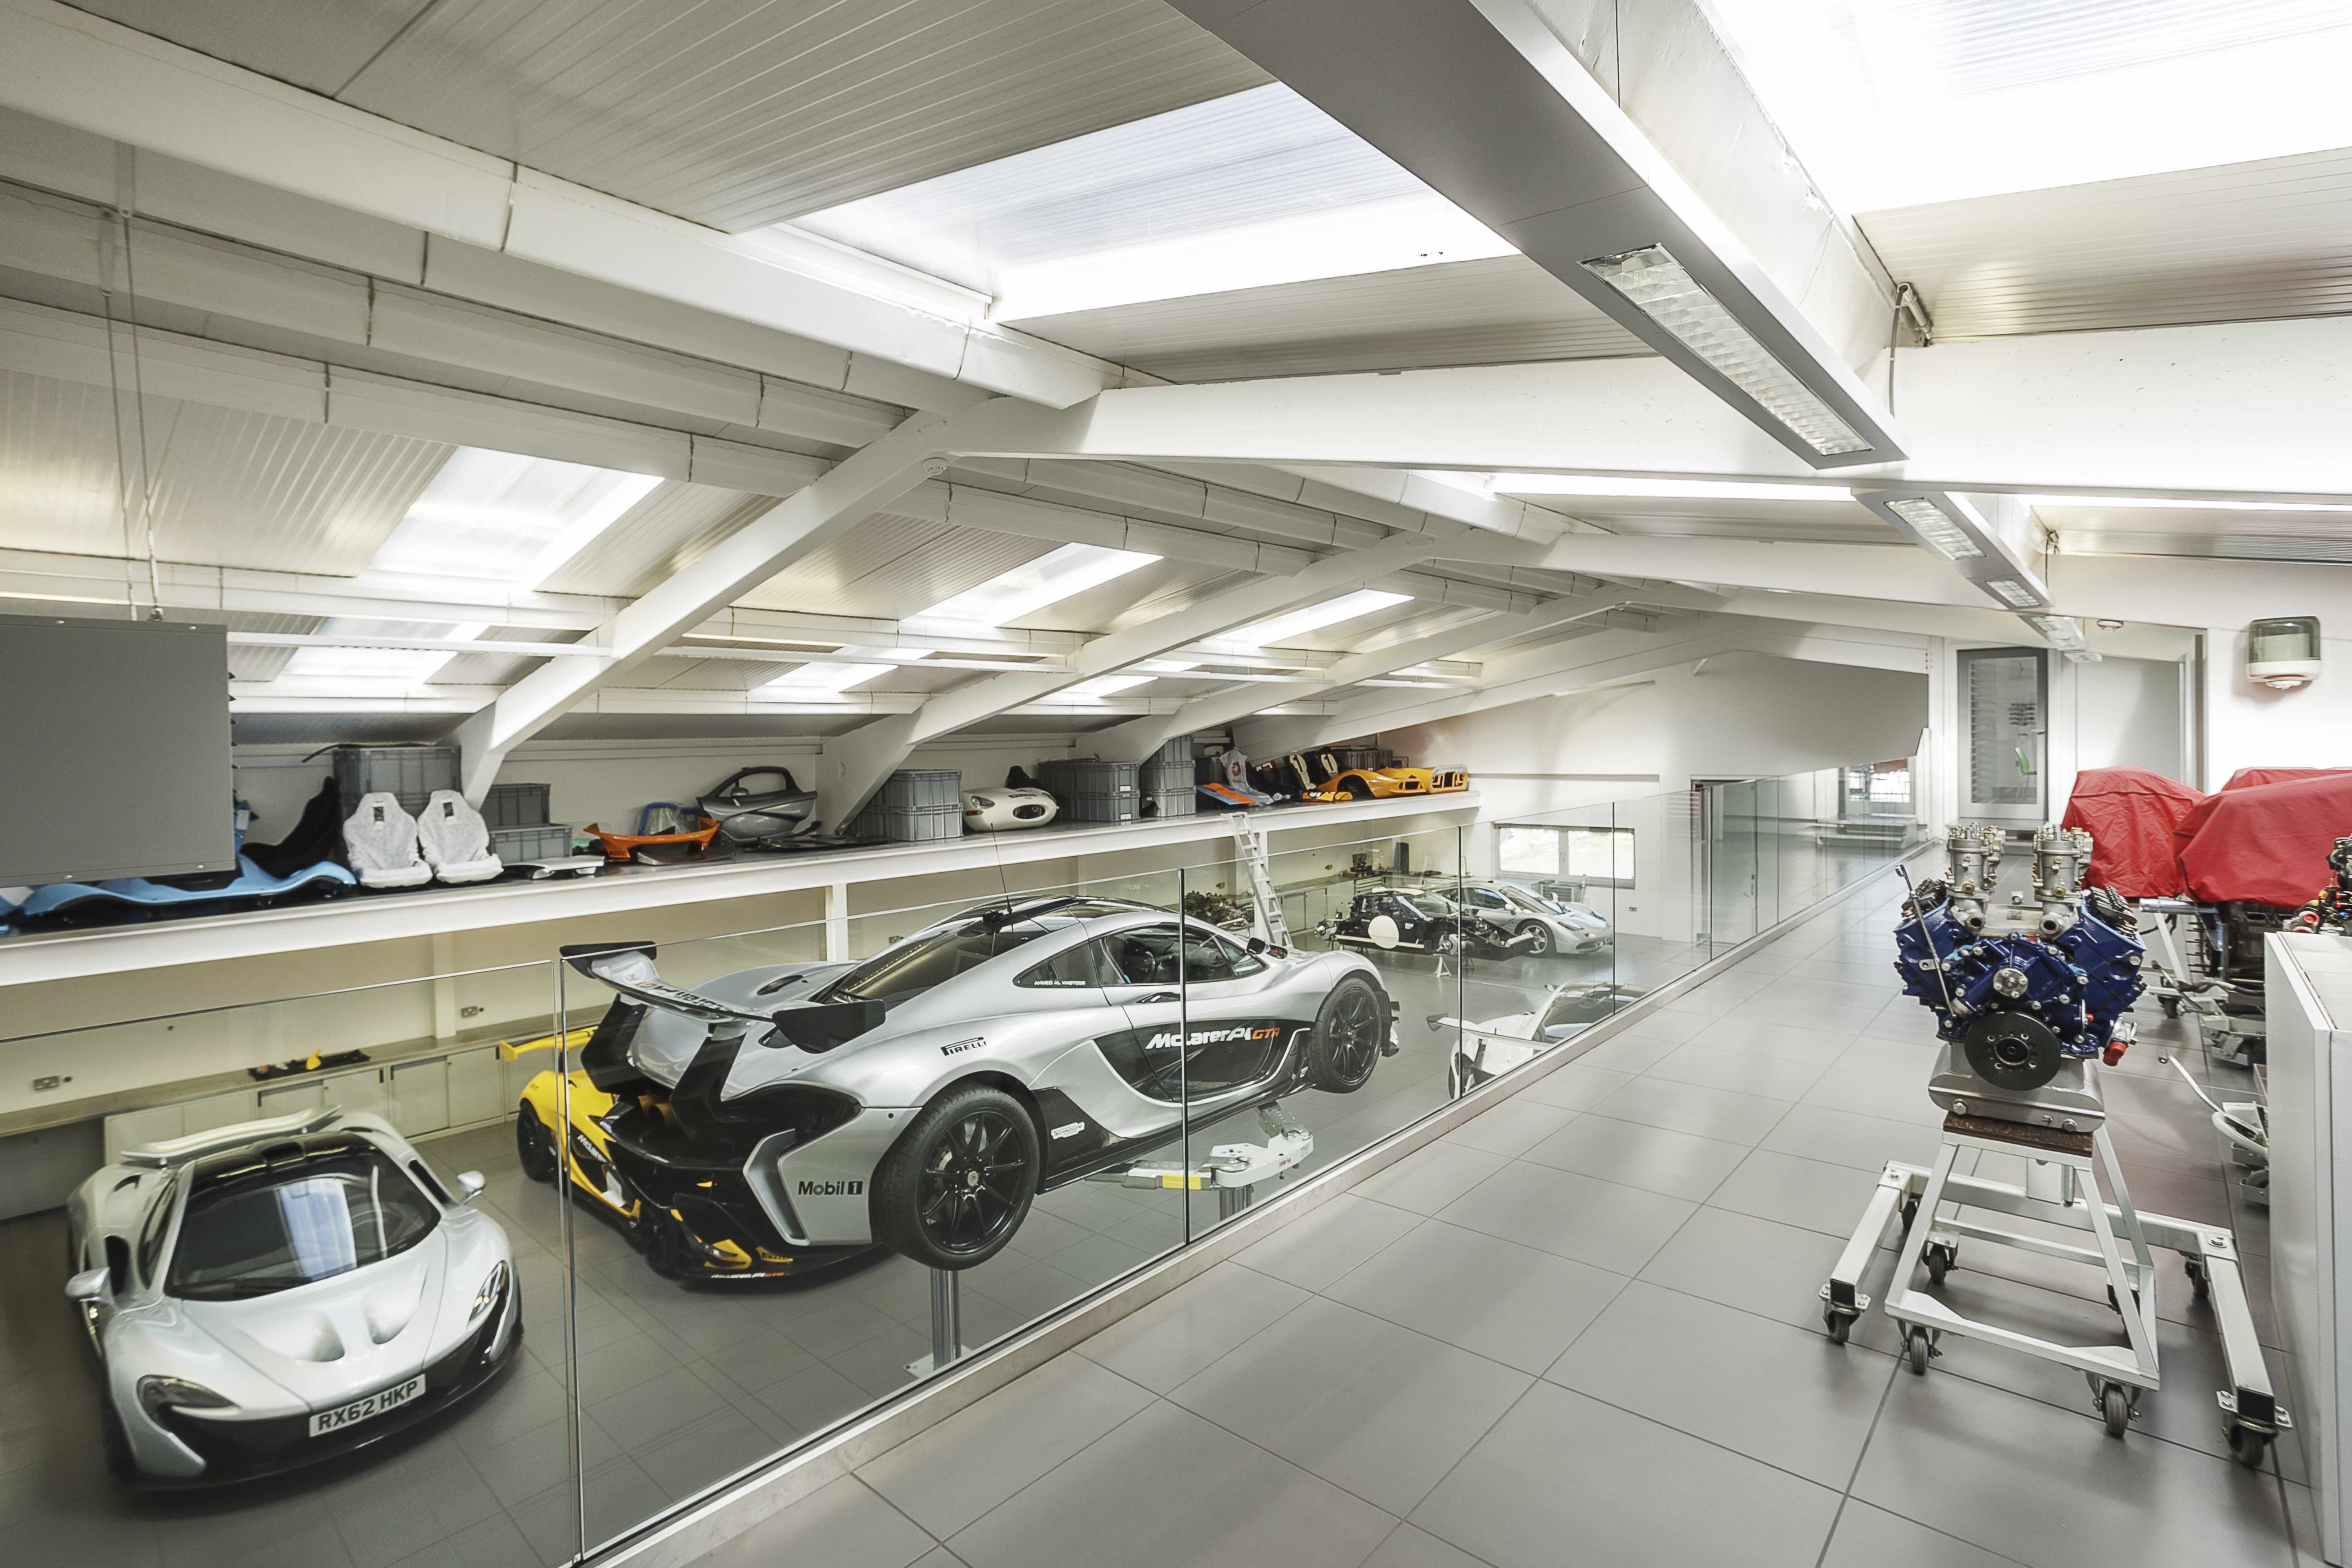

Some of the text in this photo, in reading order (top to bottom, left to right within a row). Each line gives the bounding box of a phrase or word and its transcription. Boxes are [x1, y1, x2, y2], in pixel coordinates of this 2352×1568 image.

[940, 1037, 987, 1056] PIRELLI
[798, 1181, 845, 1195] Mobil
[318, 1381, 417, 1430] RX62 HKP
